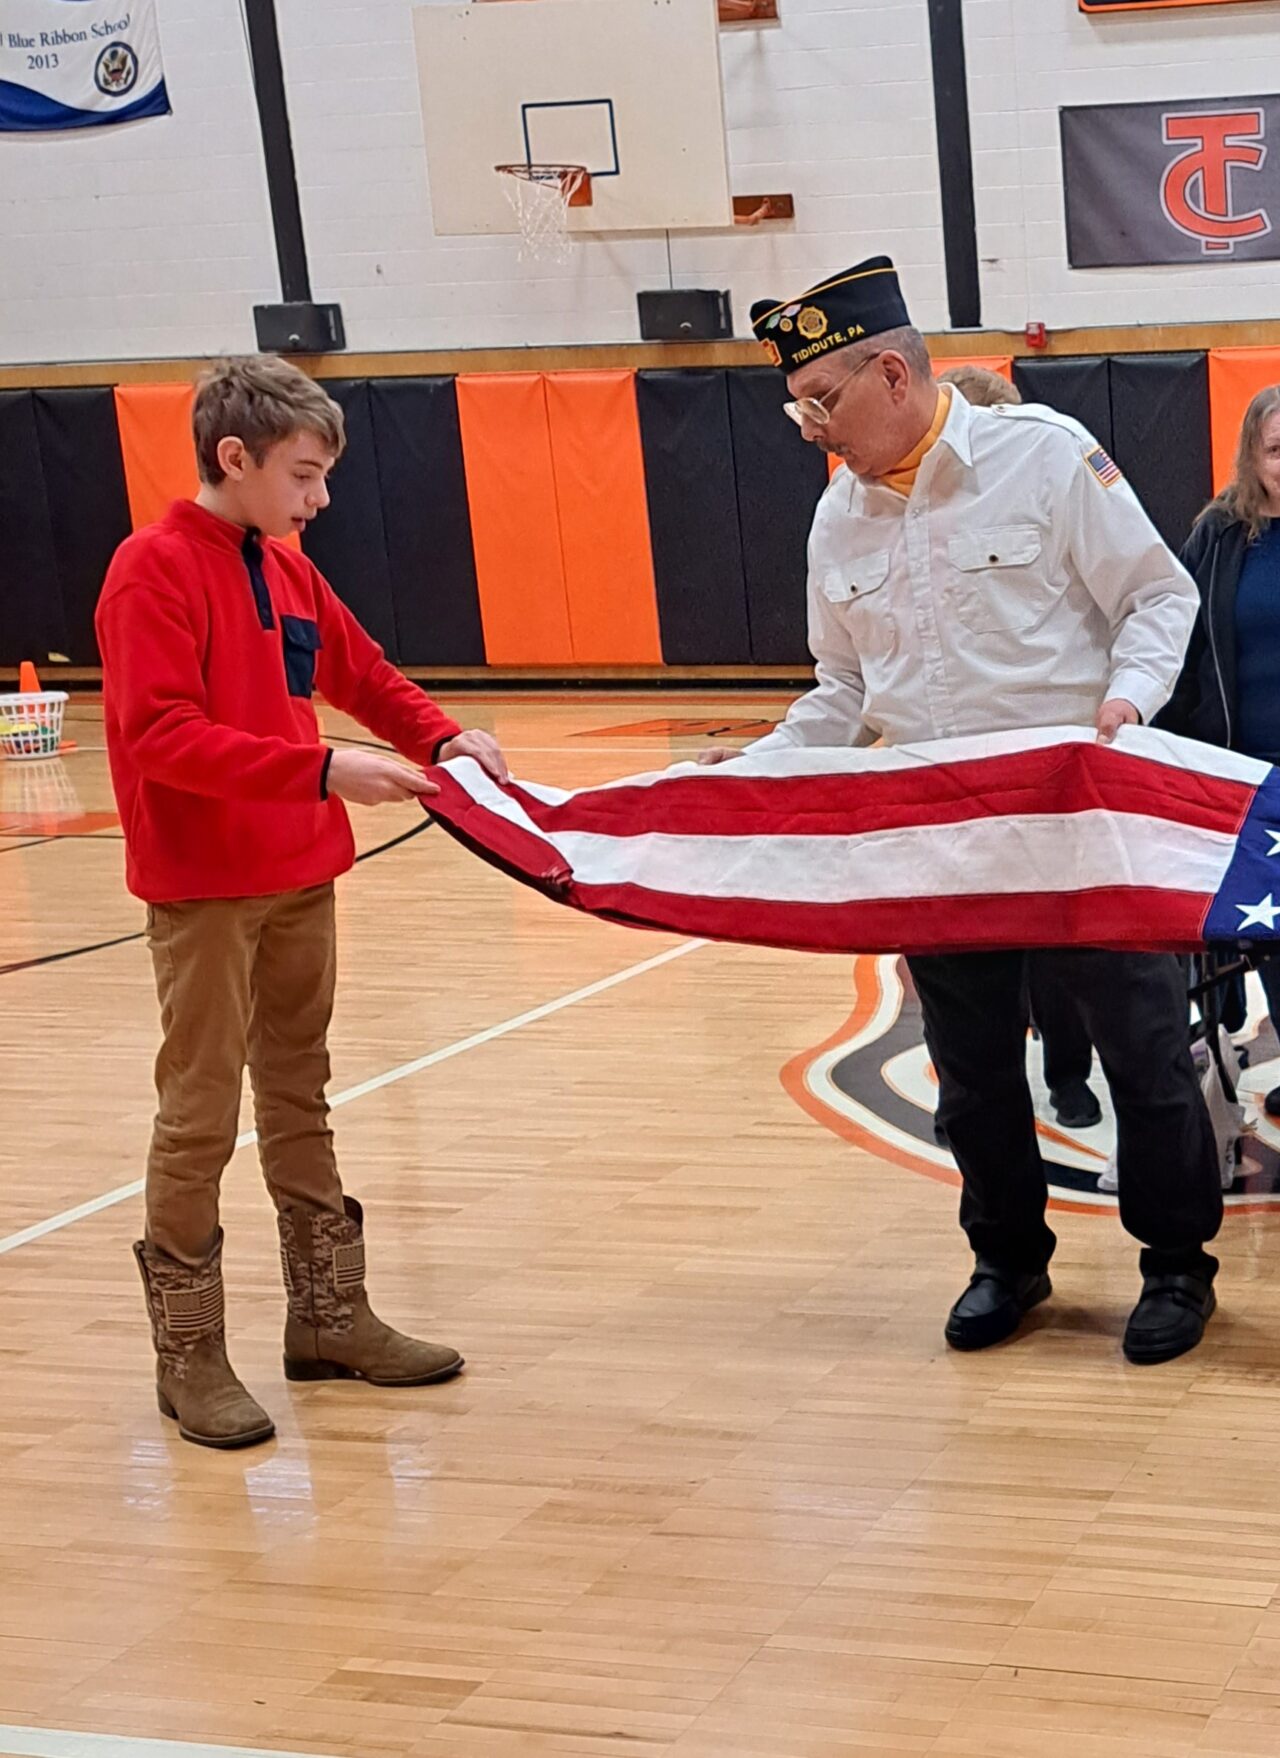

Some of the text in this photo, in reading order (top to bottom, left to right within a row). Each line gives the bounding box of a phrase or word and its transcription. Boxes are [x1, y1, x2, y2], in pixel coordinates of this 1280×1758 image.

[8, 32, 35, 48] Blue
[40, 29, 87, 47] Ribbon
[91, 13, 131, 39] School
[27, 53, 59, 70] 2013
[791, 324, 865, 363] TIDIOUTE, PA
